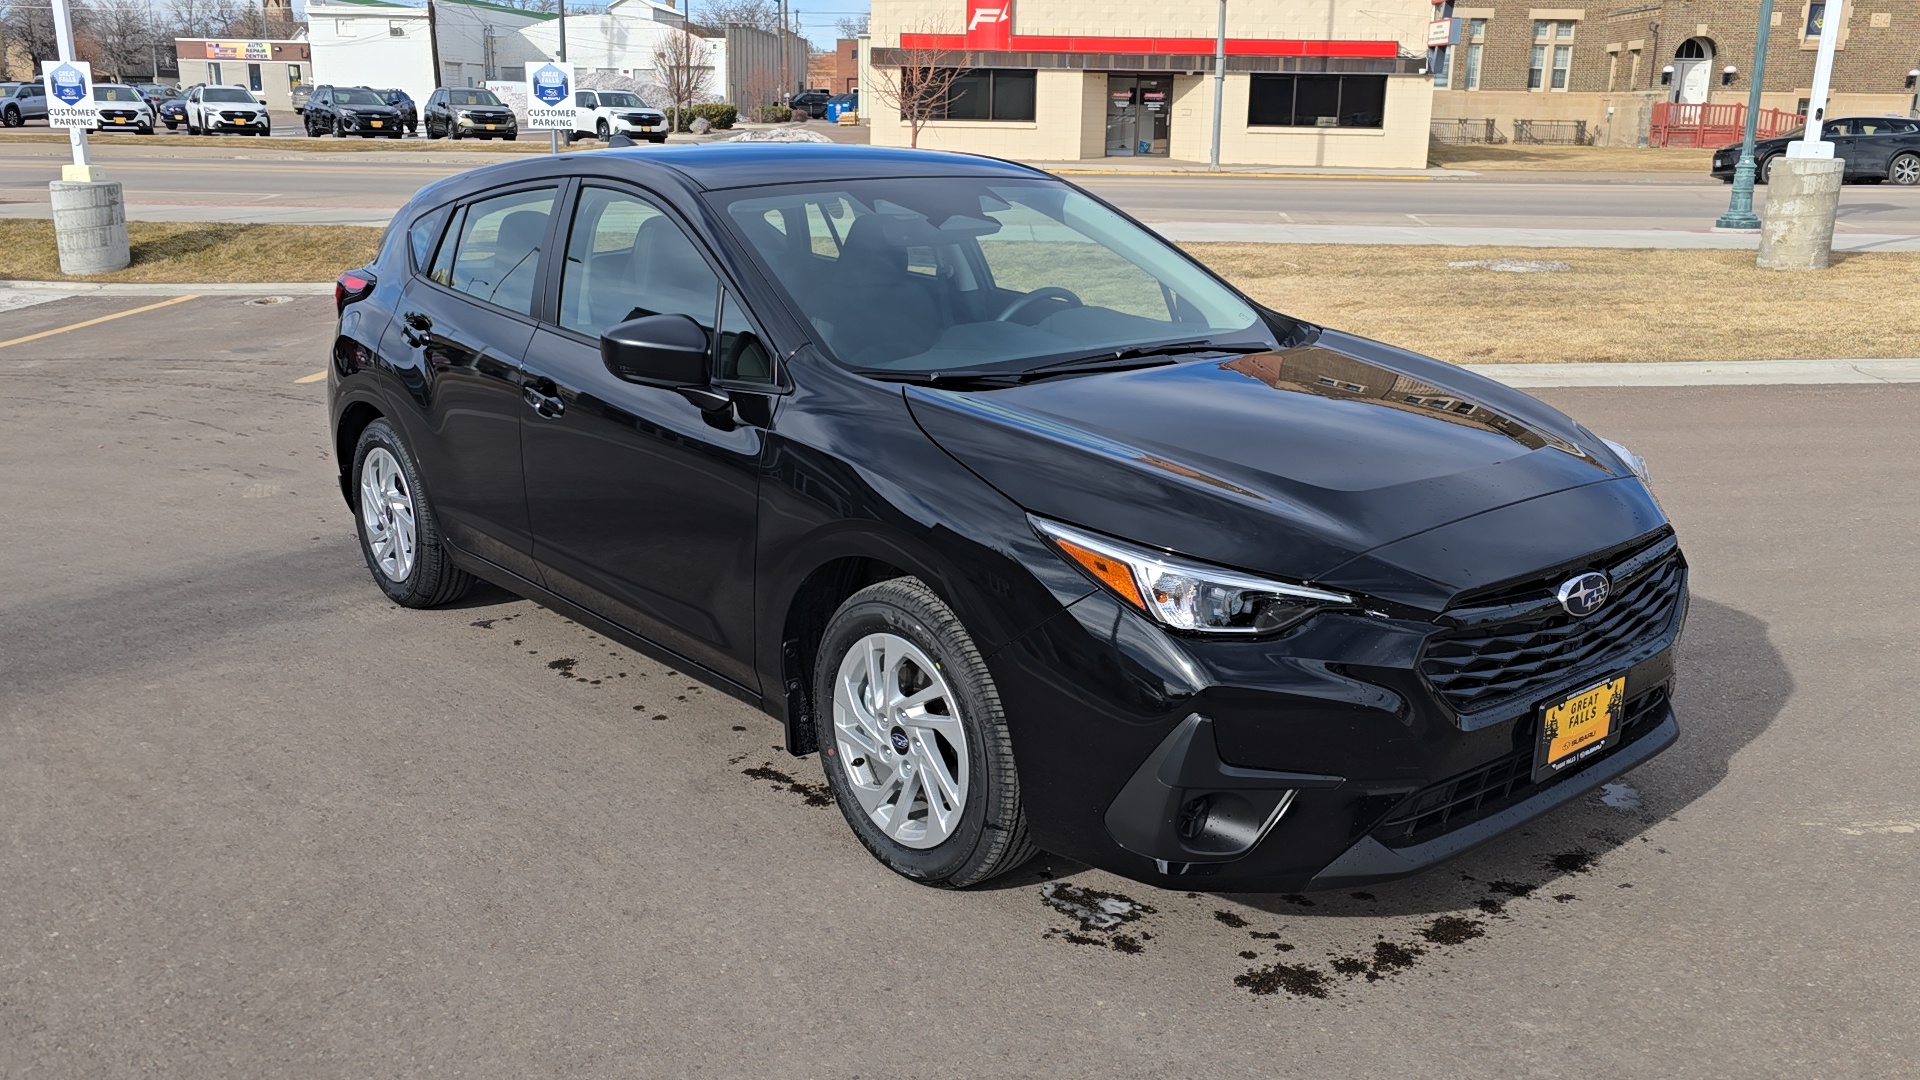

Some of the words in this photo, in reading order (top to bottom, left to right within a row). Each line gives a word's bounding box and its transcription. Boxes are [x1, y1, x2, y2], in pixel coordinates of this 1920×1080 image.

[48, 108, 96, 117] CUSTOMER
[527, 109, 577, 118] CUSTOMER
[54, 118, 93, 126] PARKING
[532, 118, 572, 127] PARKING
[1570, 692, 1599, 714] GREAT
[1568, 706, 1597, 729] FALLS
[1571, 730, 1596, 746] SUBARU
